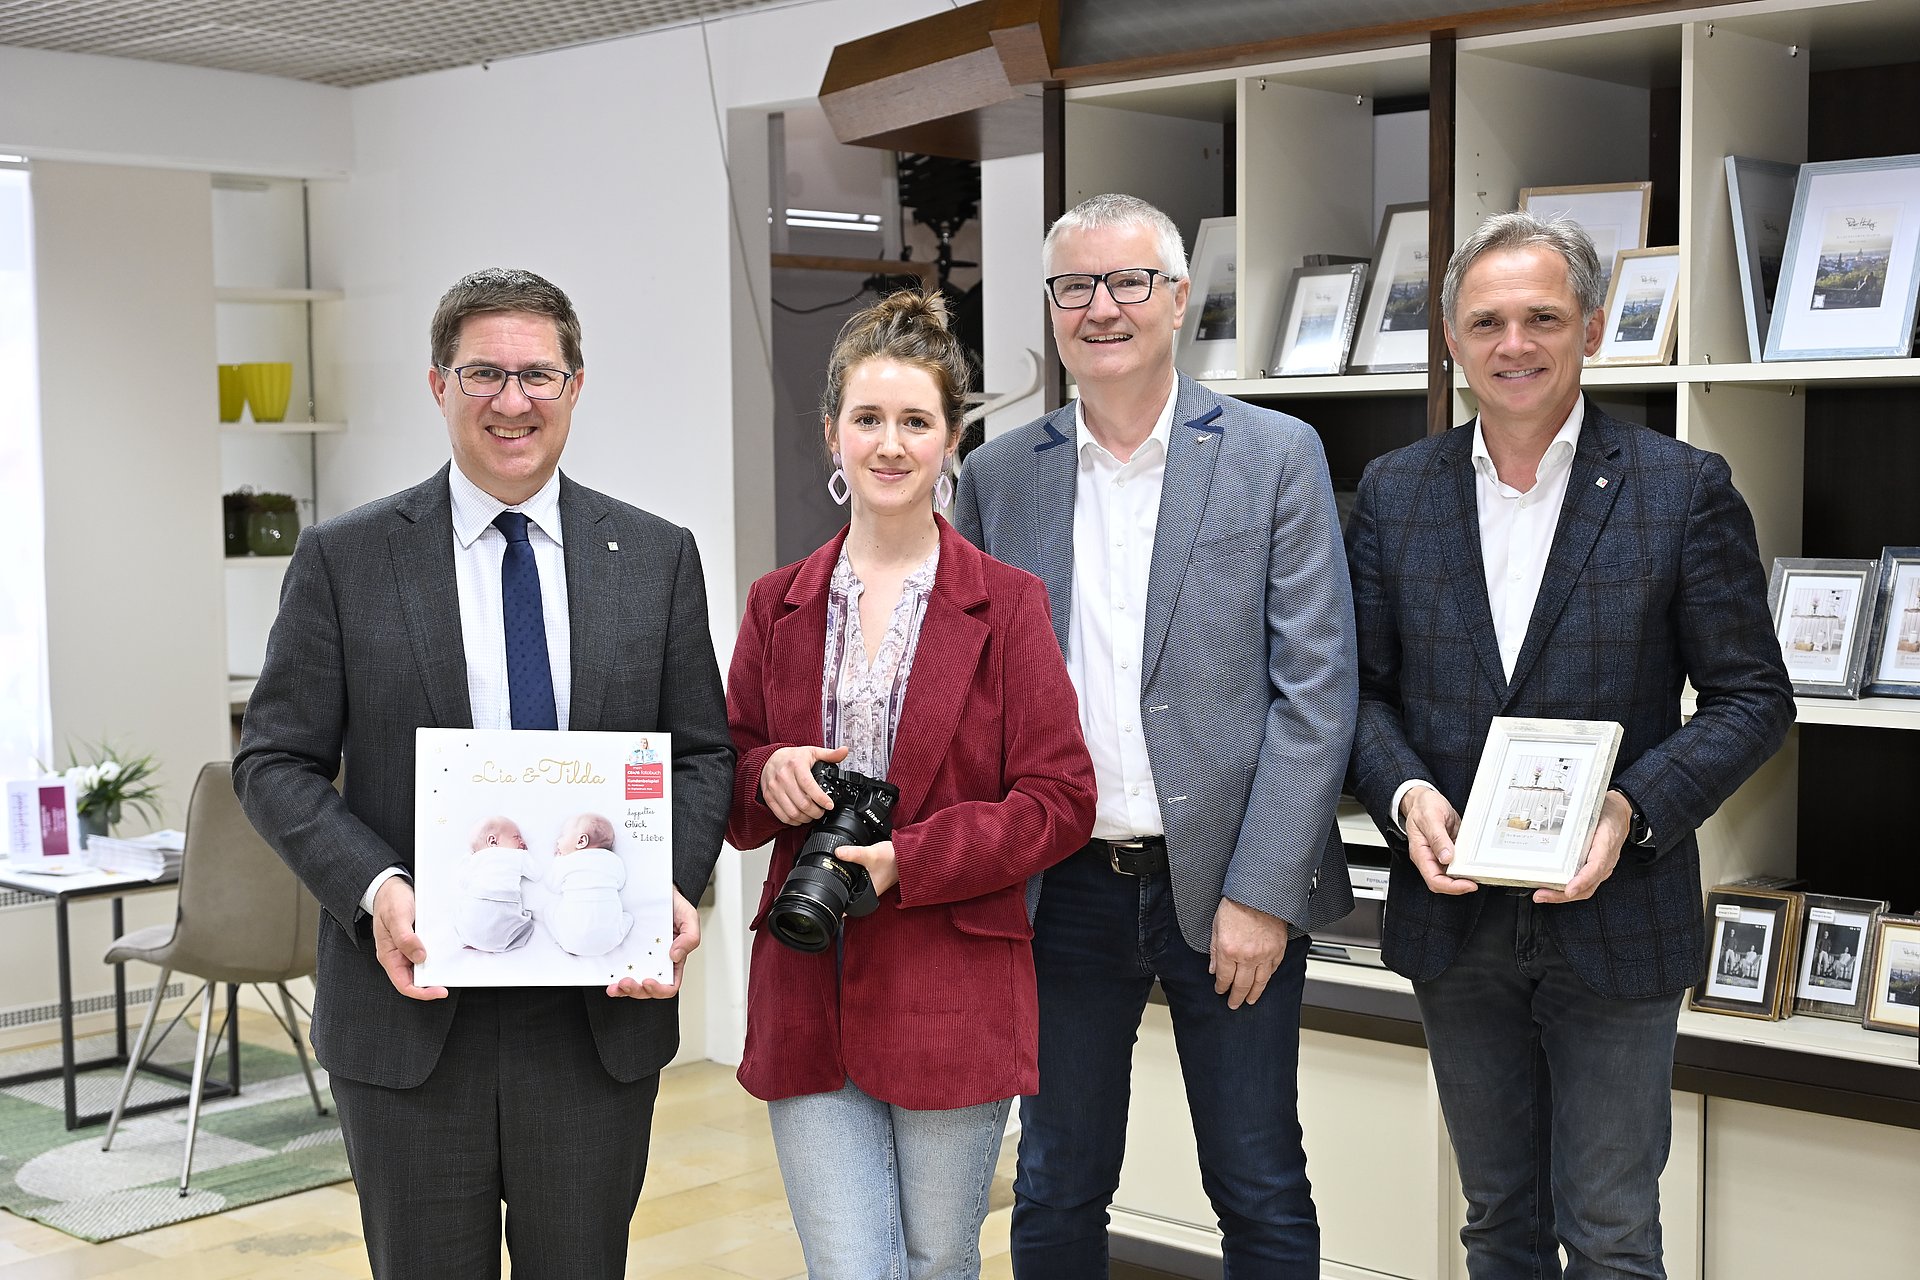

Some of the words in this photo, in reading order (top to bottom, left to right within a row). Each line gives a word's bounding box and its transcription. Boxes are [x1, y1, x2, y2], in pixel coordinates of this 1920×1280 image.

[472, 760, 518, 783] Lia
[522, 767, 540, 783] &
[538, 758, 606, 784] Tilda
[865, 809, 880, 823] Nikon
[625, 820, 647, 828] Glück
[640, 833, 664, 842] Liebe
